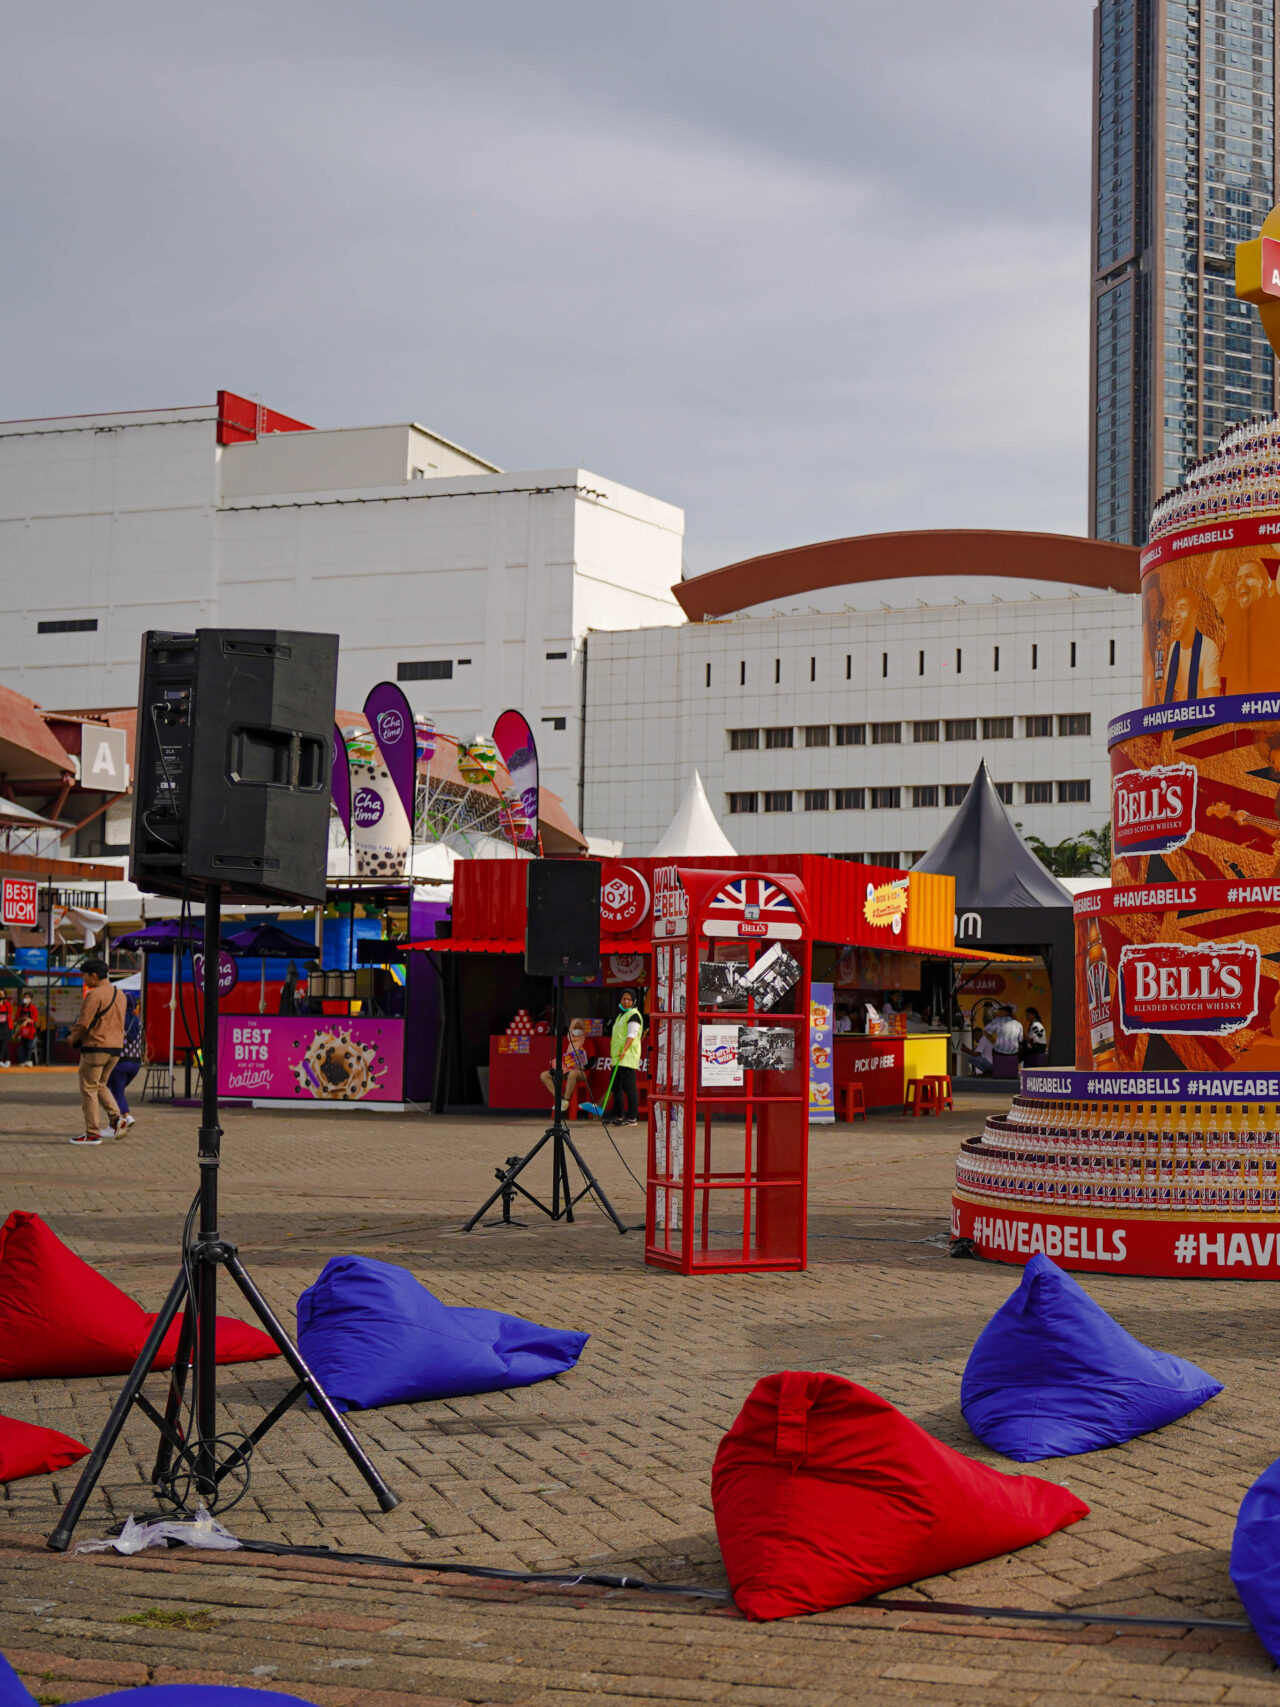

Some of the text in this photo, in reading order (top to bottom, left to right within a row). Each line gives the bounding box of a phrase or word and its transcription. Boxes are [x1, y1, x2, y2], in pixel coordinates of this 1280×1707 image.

[1172, 528, 1234, 551] #HAVEABELLS
[383, 716, 400, 729] Cha
[1143, 704, 1216, 727] #HAVEABELLS
[383, 728, 400, 739] time
[92, 742, 116, 775] A
[355, 793, 381, 810] Cha
[1117, 779, 1184, 827] BELL'S
[354, 809, 380, 822] time
[1134, 823, 1155, 834] SCOTCH
[1156, 820, 1183, 831] WHISKY
[654, 865, 679, 893] WALL
[6, 884, 34, 900] BEST
[1113, 887, 1197, 908] #HAVEABELLS
[5, 901, 34, 920] WOK
[662, 889, 689, 919] BELL'S
[616, 912, 622, 920] &
[624, 907, 636, 918] CO
[741, 923, 766, 933] BELL'S
[1134, 957, 1243, 1002] BELL'S
[1091, 1003, 1110, 1025] BELL'S
[1134, 1002, 1243, 1013] BLENDED SCOTCH WHISKY
[232, 1029, 272, 1044] BEST
[235, 1045, 269, 1060] BITS
[855, 1054, 895, 1072] PICK UP HERE
[228, 1069, 273, 1089] bottom
[1026, 1077, 1072, 1094] #HAVEABELLS
[1087, 1078, 1181, 1095] #HAVEABELLS
[973, 1216, 1127, 1262] #HAVEABELLS
